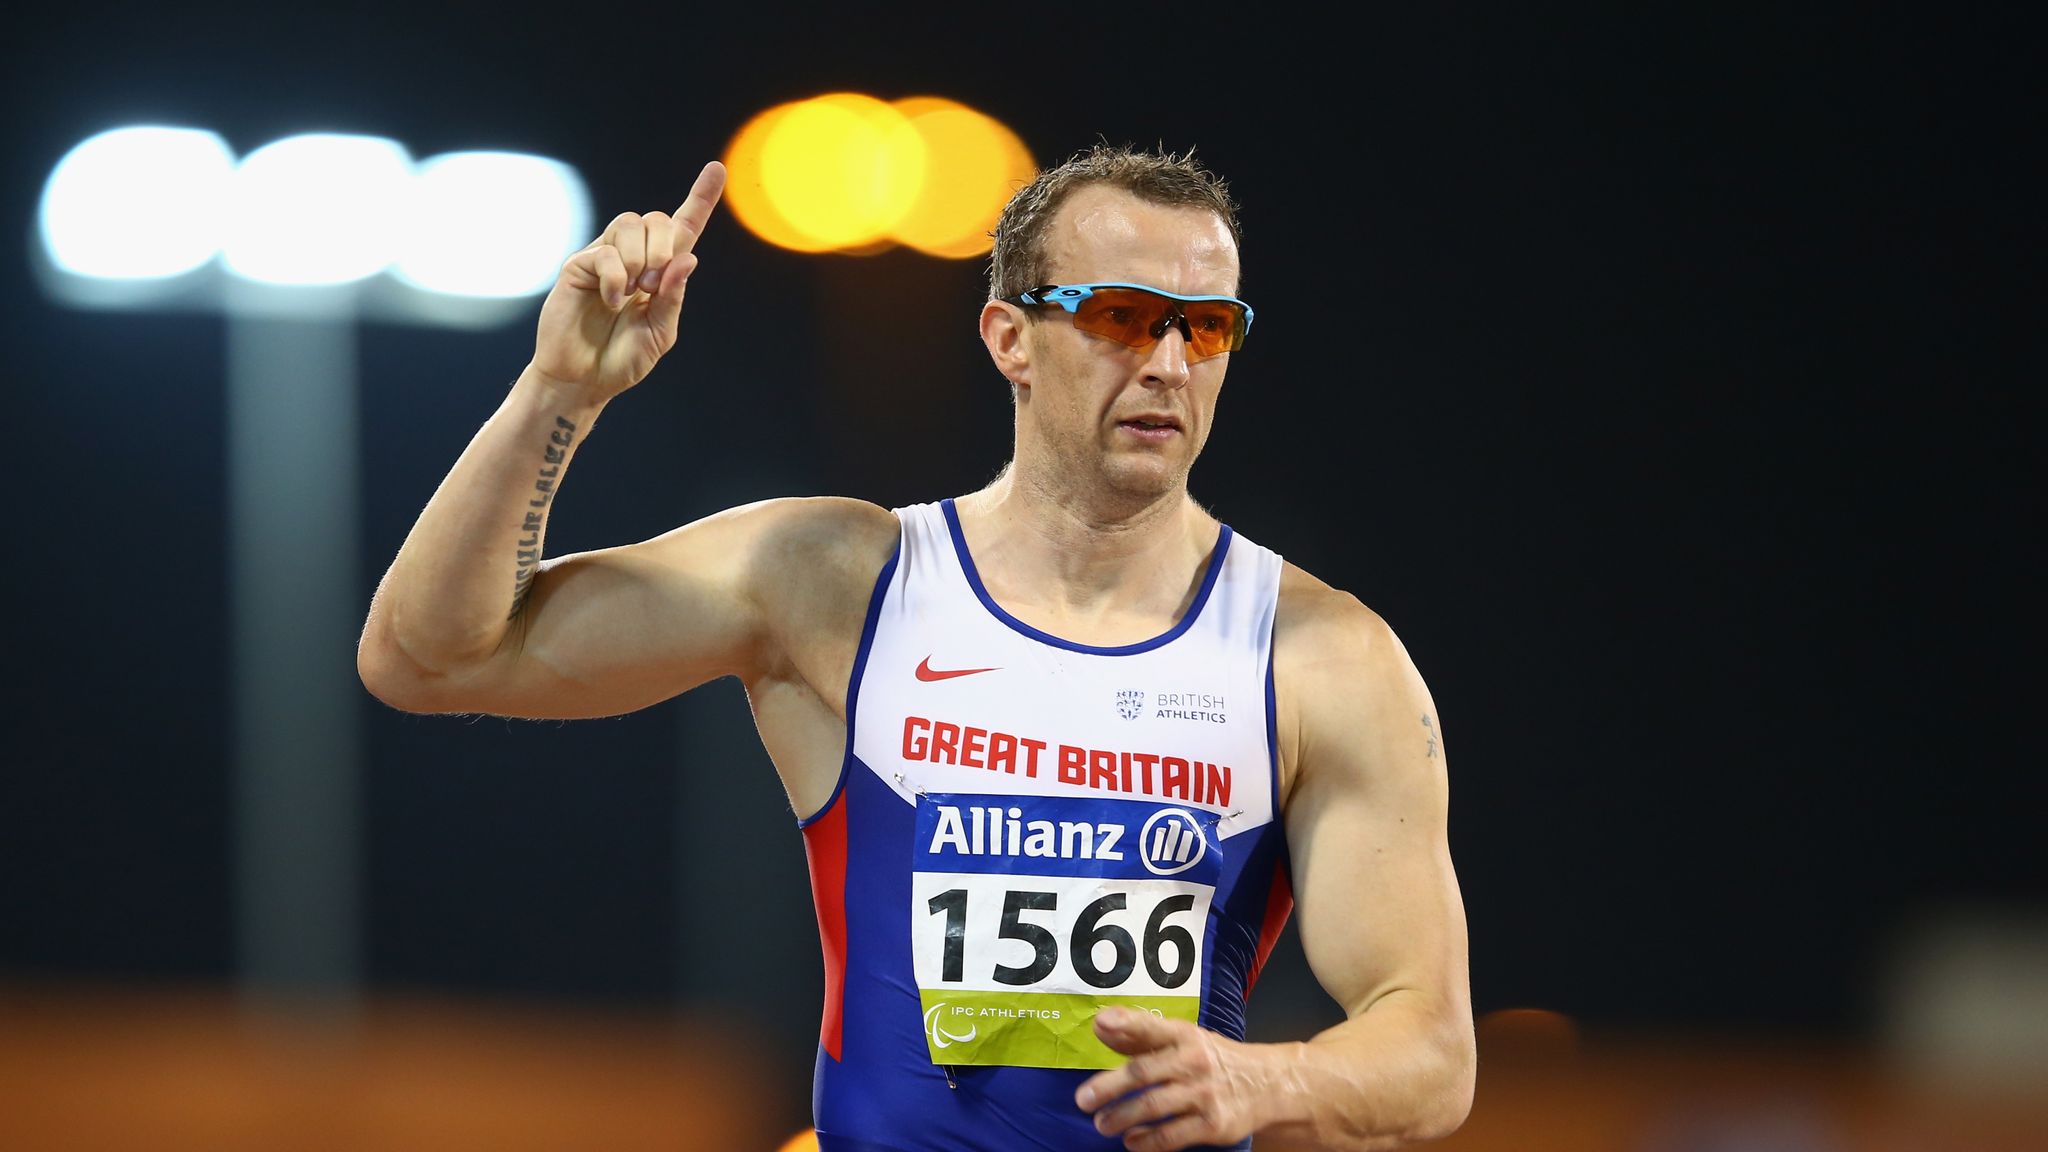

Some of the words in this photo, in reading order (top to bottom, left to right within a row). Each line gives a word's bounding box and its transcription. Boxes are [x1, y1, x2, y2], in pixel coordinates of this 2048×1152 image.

[1156, 709, 1227, 724] ATHLETICS
[1158, 693, 1225, 709] BRITISH
[902, 716, 1047, 778] GREAT
[1058, 744, 1232, 807] BRITAIN
[929, 805, 1125, 861] Allianz
[927, 888, 1196, 989] 1566
[951, 1006, 975, 1017] IPC
[979, 1008, 1061, 1020] ATHLETICS
